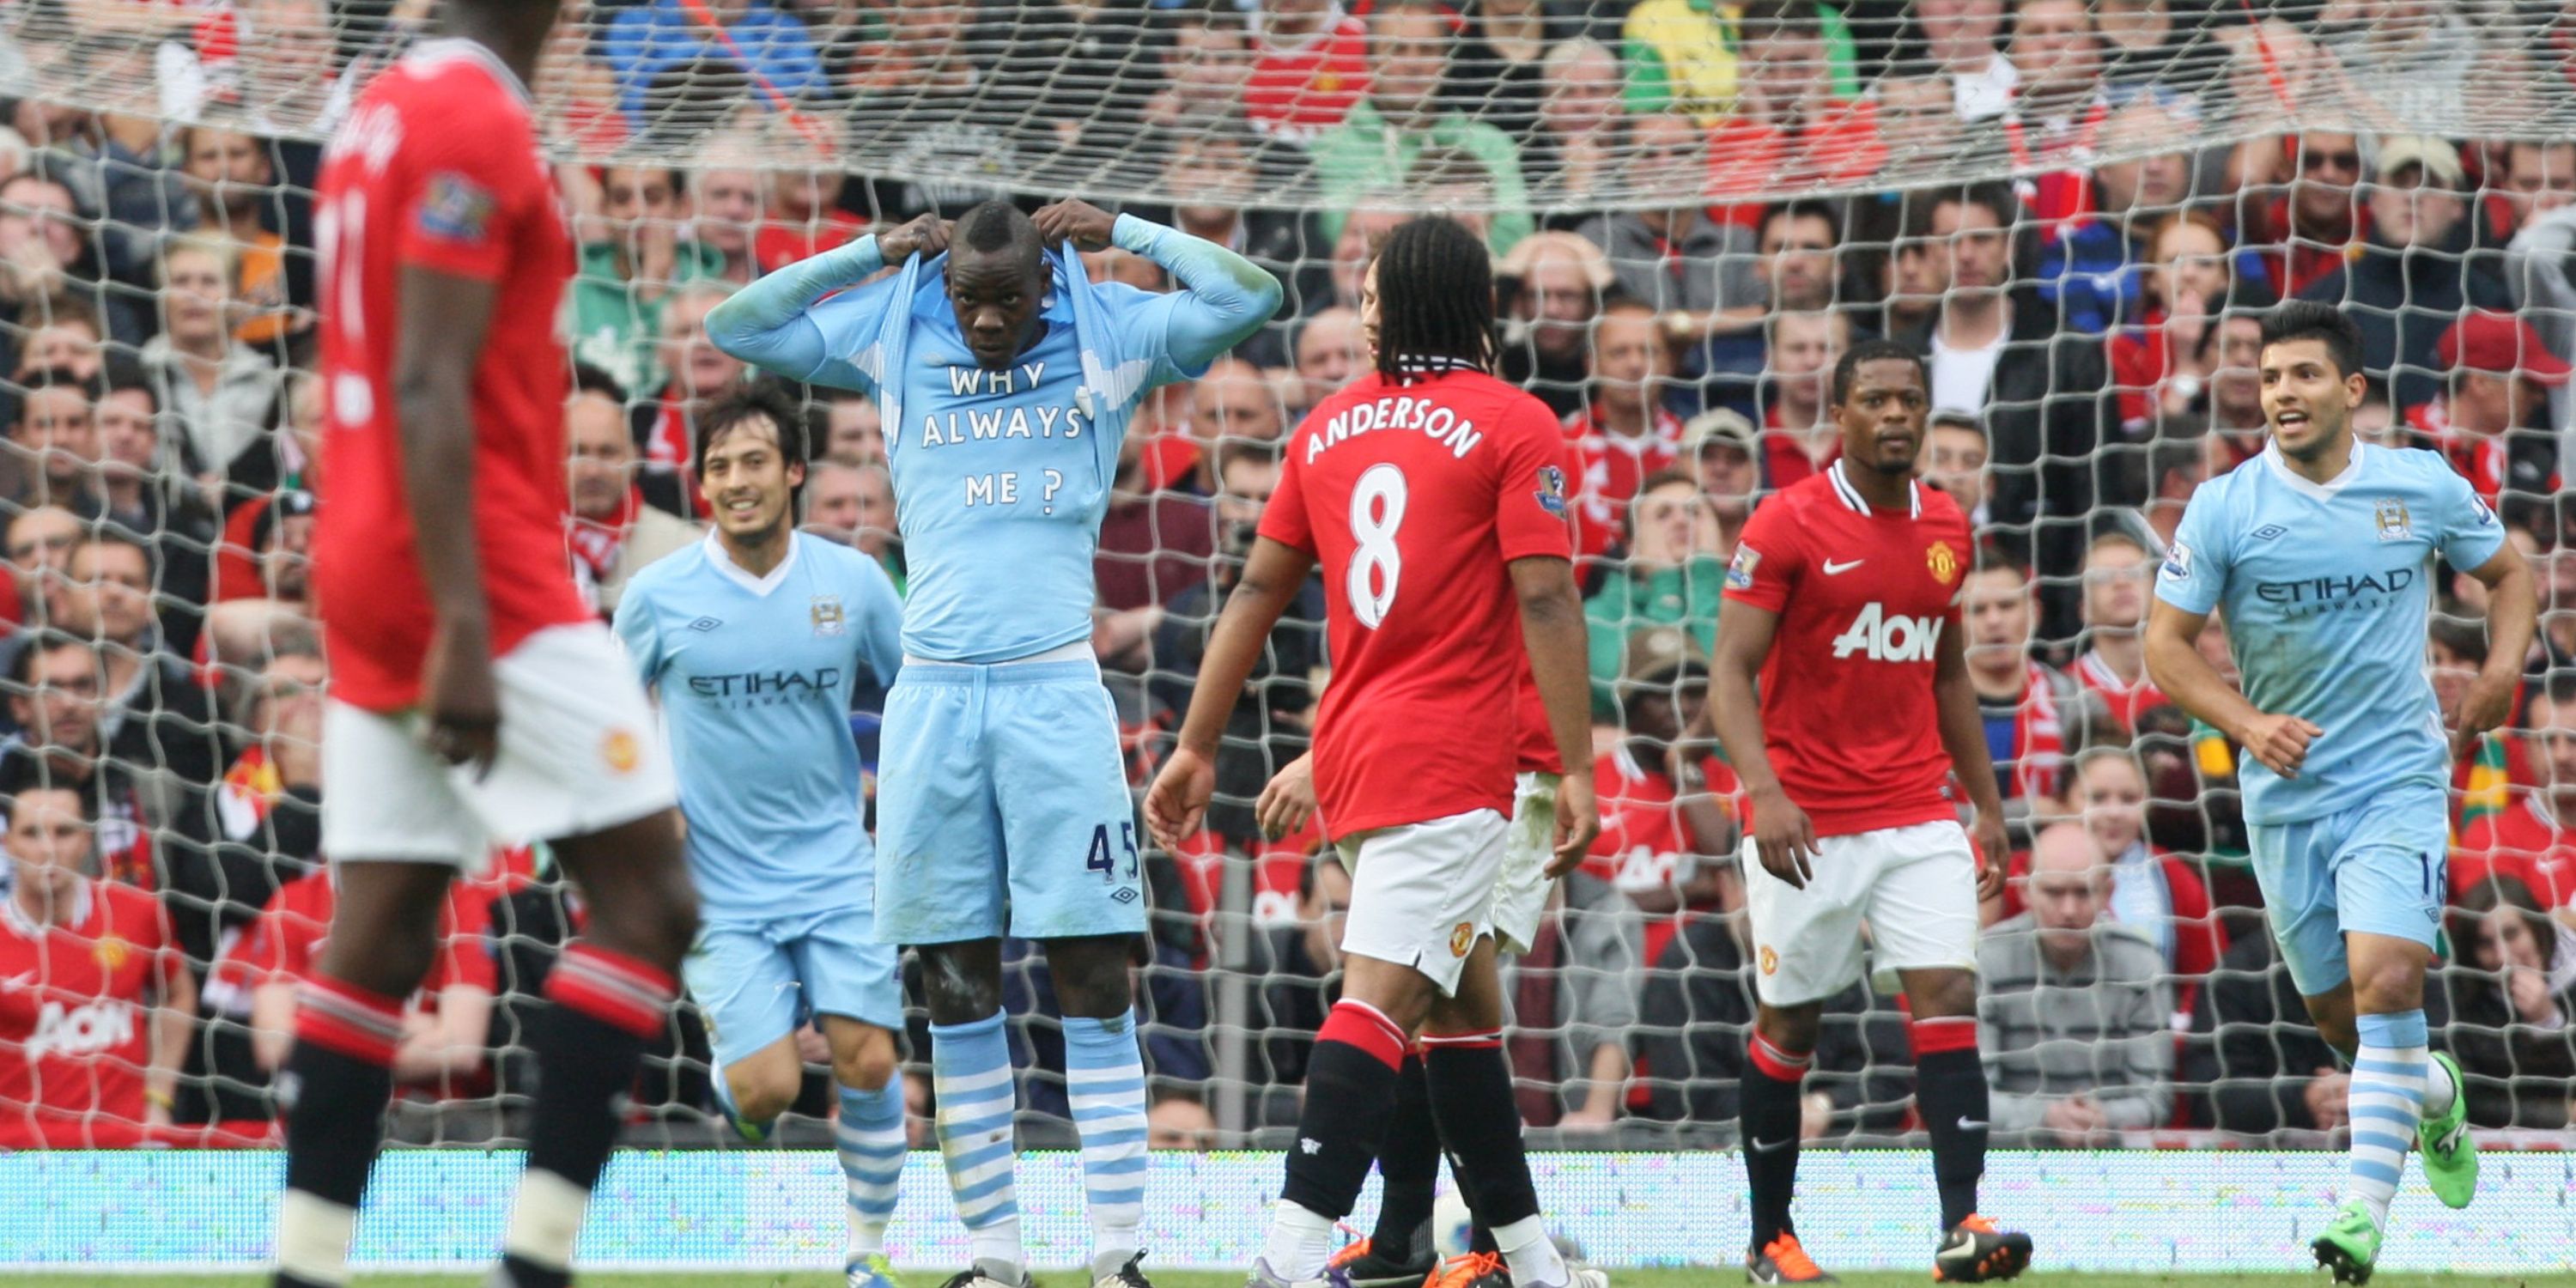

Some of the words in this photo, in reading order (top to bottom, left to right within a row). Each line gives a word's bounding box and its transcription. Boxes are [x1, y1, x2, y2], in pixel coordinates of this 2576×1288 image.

[948, 361, 1046, 396] WHY
[920, 406, 1082, 448] ALWAYS
[1306, 397, 1483, 465] ANDERSON
[965, 473, 1018, 507] ME
[1041, 468, 1064, 515] ?
[1346, 462, 1408, 631] 8
[2255, 568, 2415, 603] ETIHAD
[2281, 597, 2396, 618] AIRWAYS
[1832, 602, 1946, 662] AON
[689, 667, 841, 696] ETIHAD
[714, 693, 821, 710] AIRWAYS
[1086, 821, 1139, 882] 45
[2420, 851, 2446, 904] 16
[24, 1000, 135, 1064] AON
